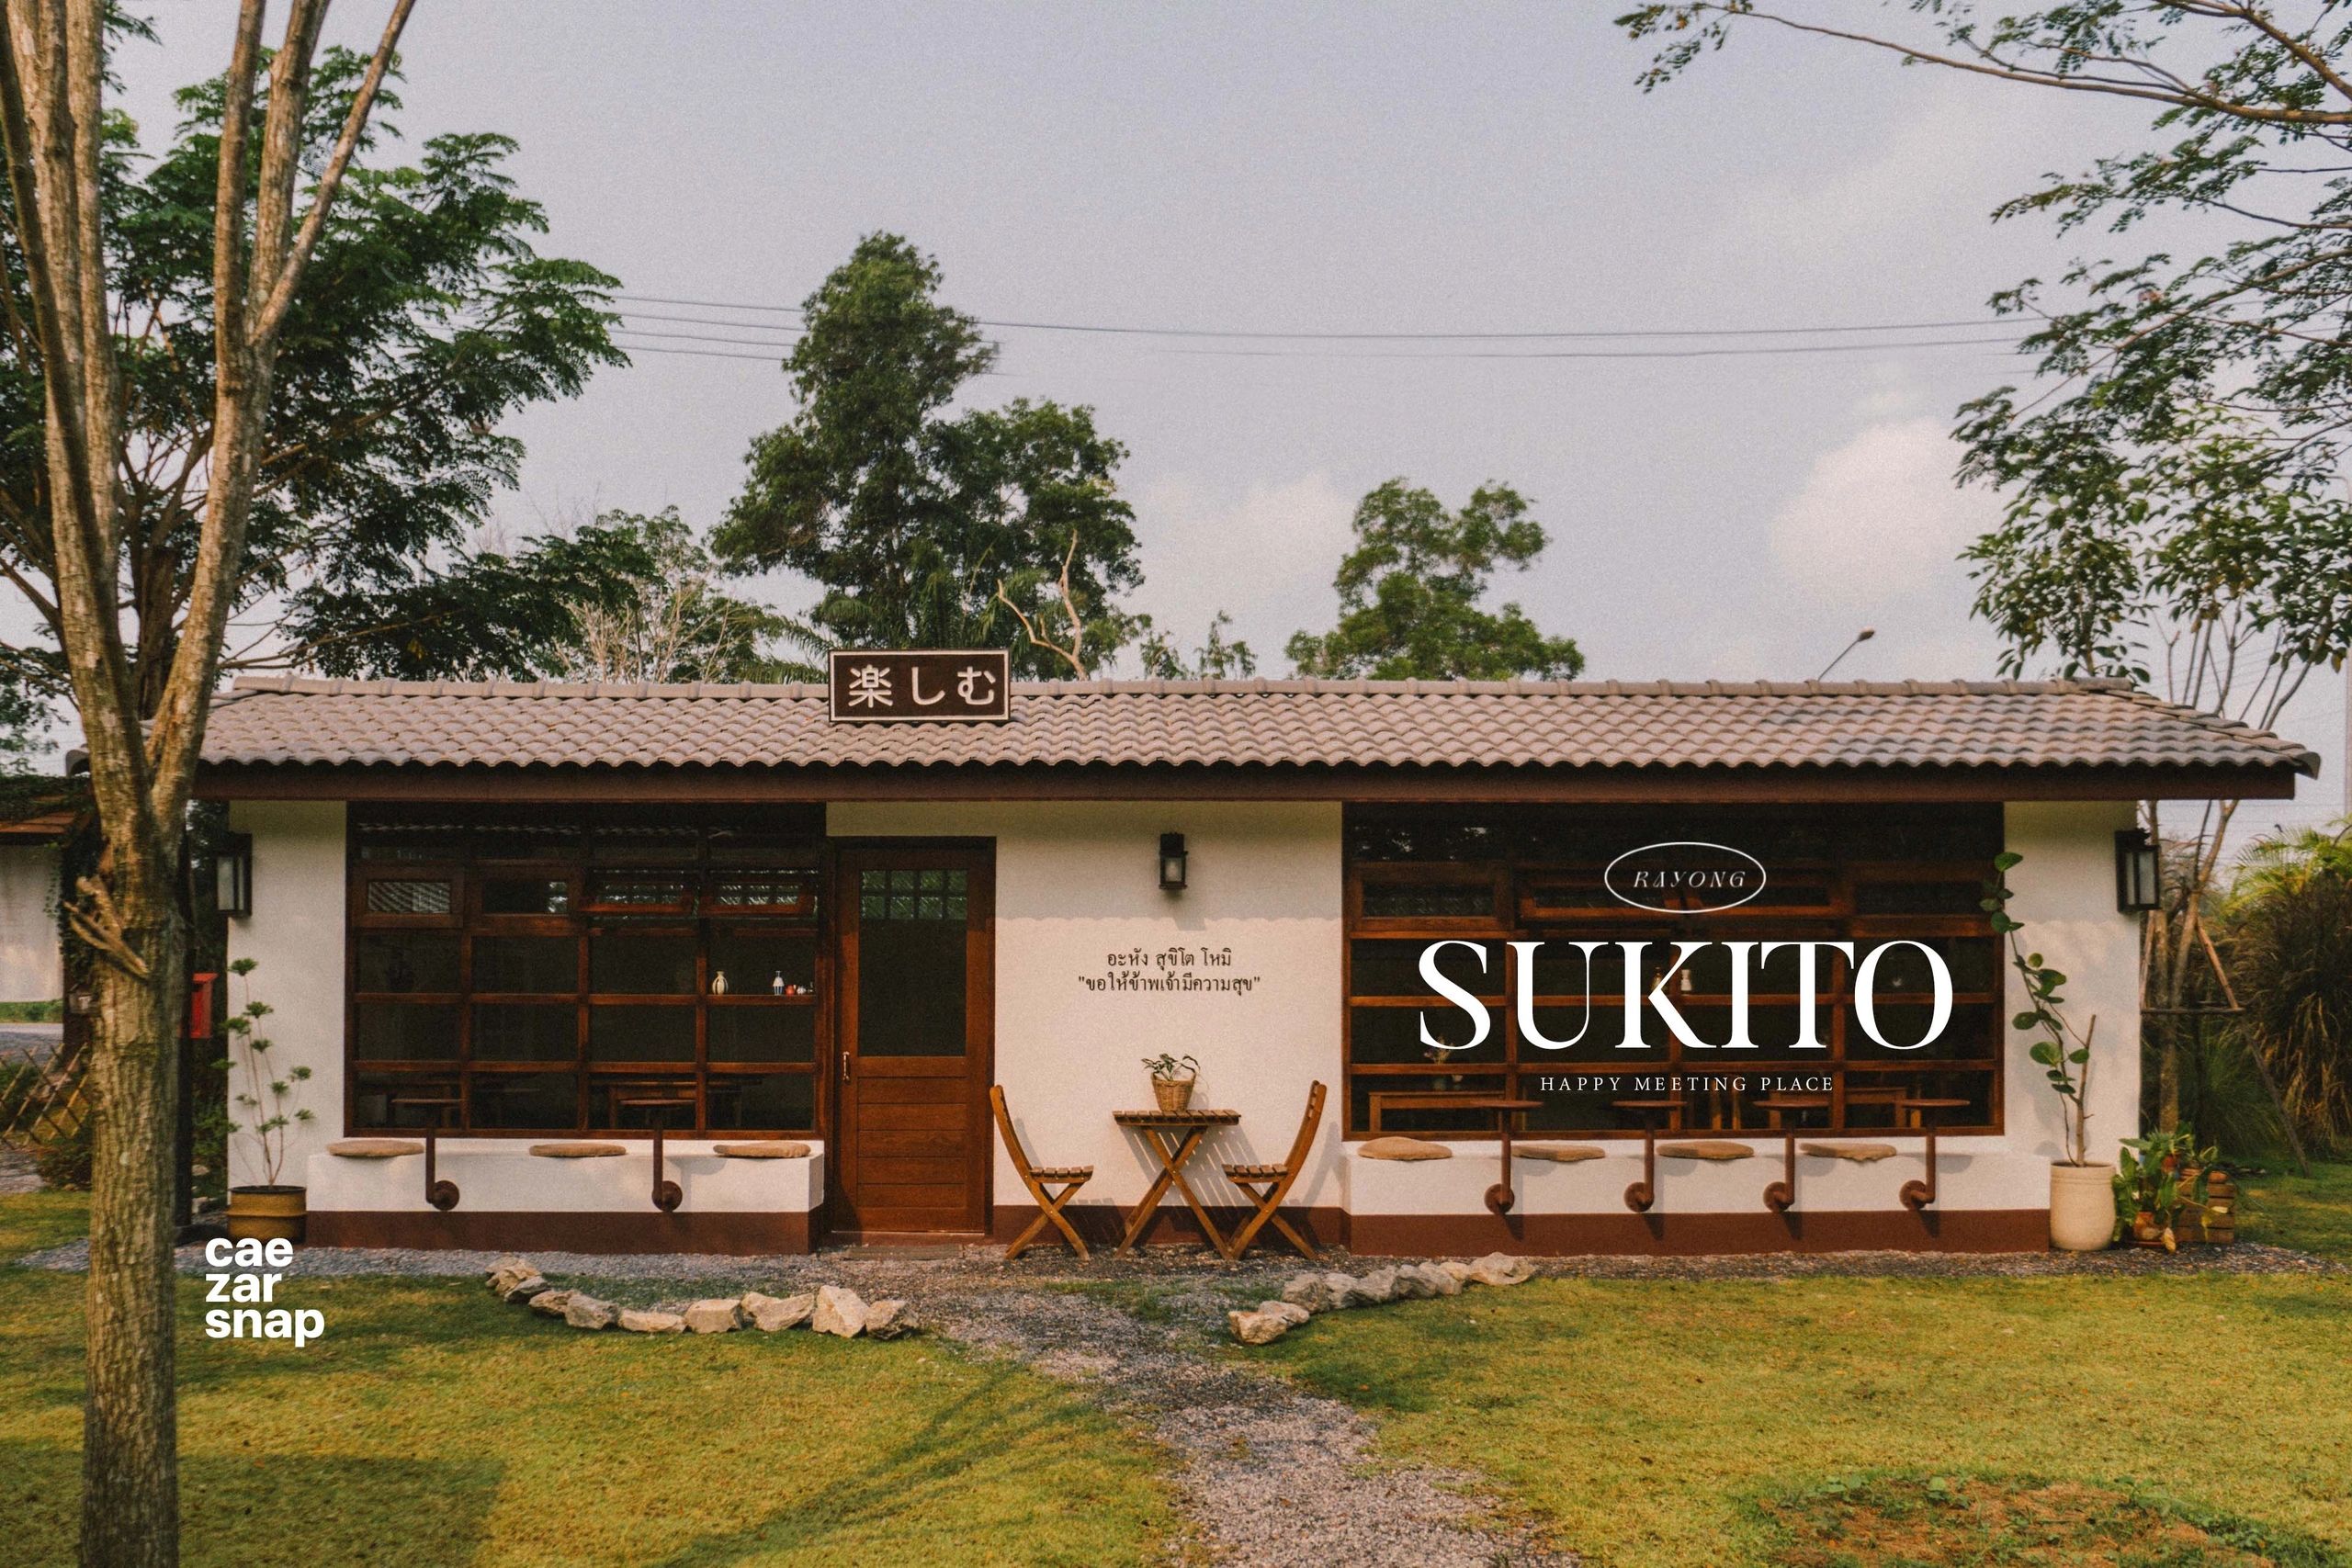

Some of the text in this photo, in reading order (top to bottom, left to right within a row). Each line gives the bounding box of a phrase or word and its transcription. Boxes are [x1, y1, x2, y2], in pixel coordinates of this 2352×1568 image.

[848, 664, 997, 708] 楽しむ
[1107, 947, 1232, 971] อะหัง สุขิโต โหมิ
[1078, 971, 1261, 996] "ขอให้ข้าพเจ้ามีความสุข"
